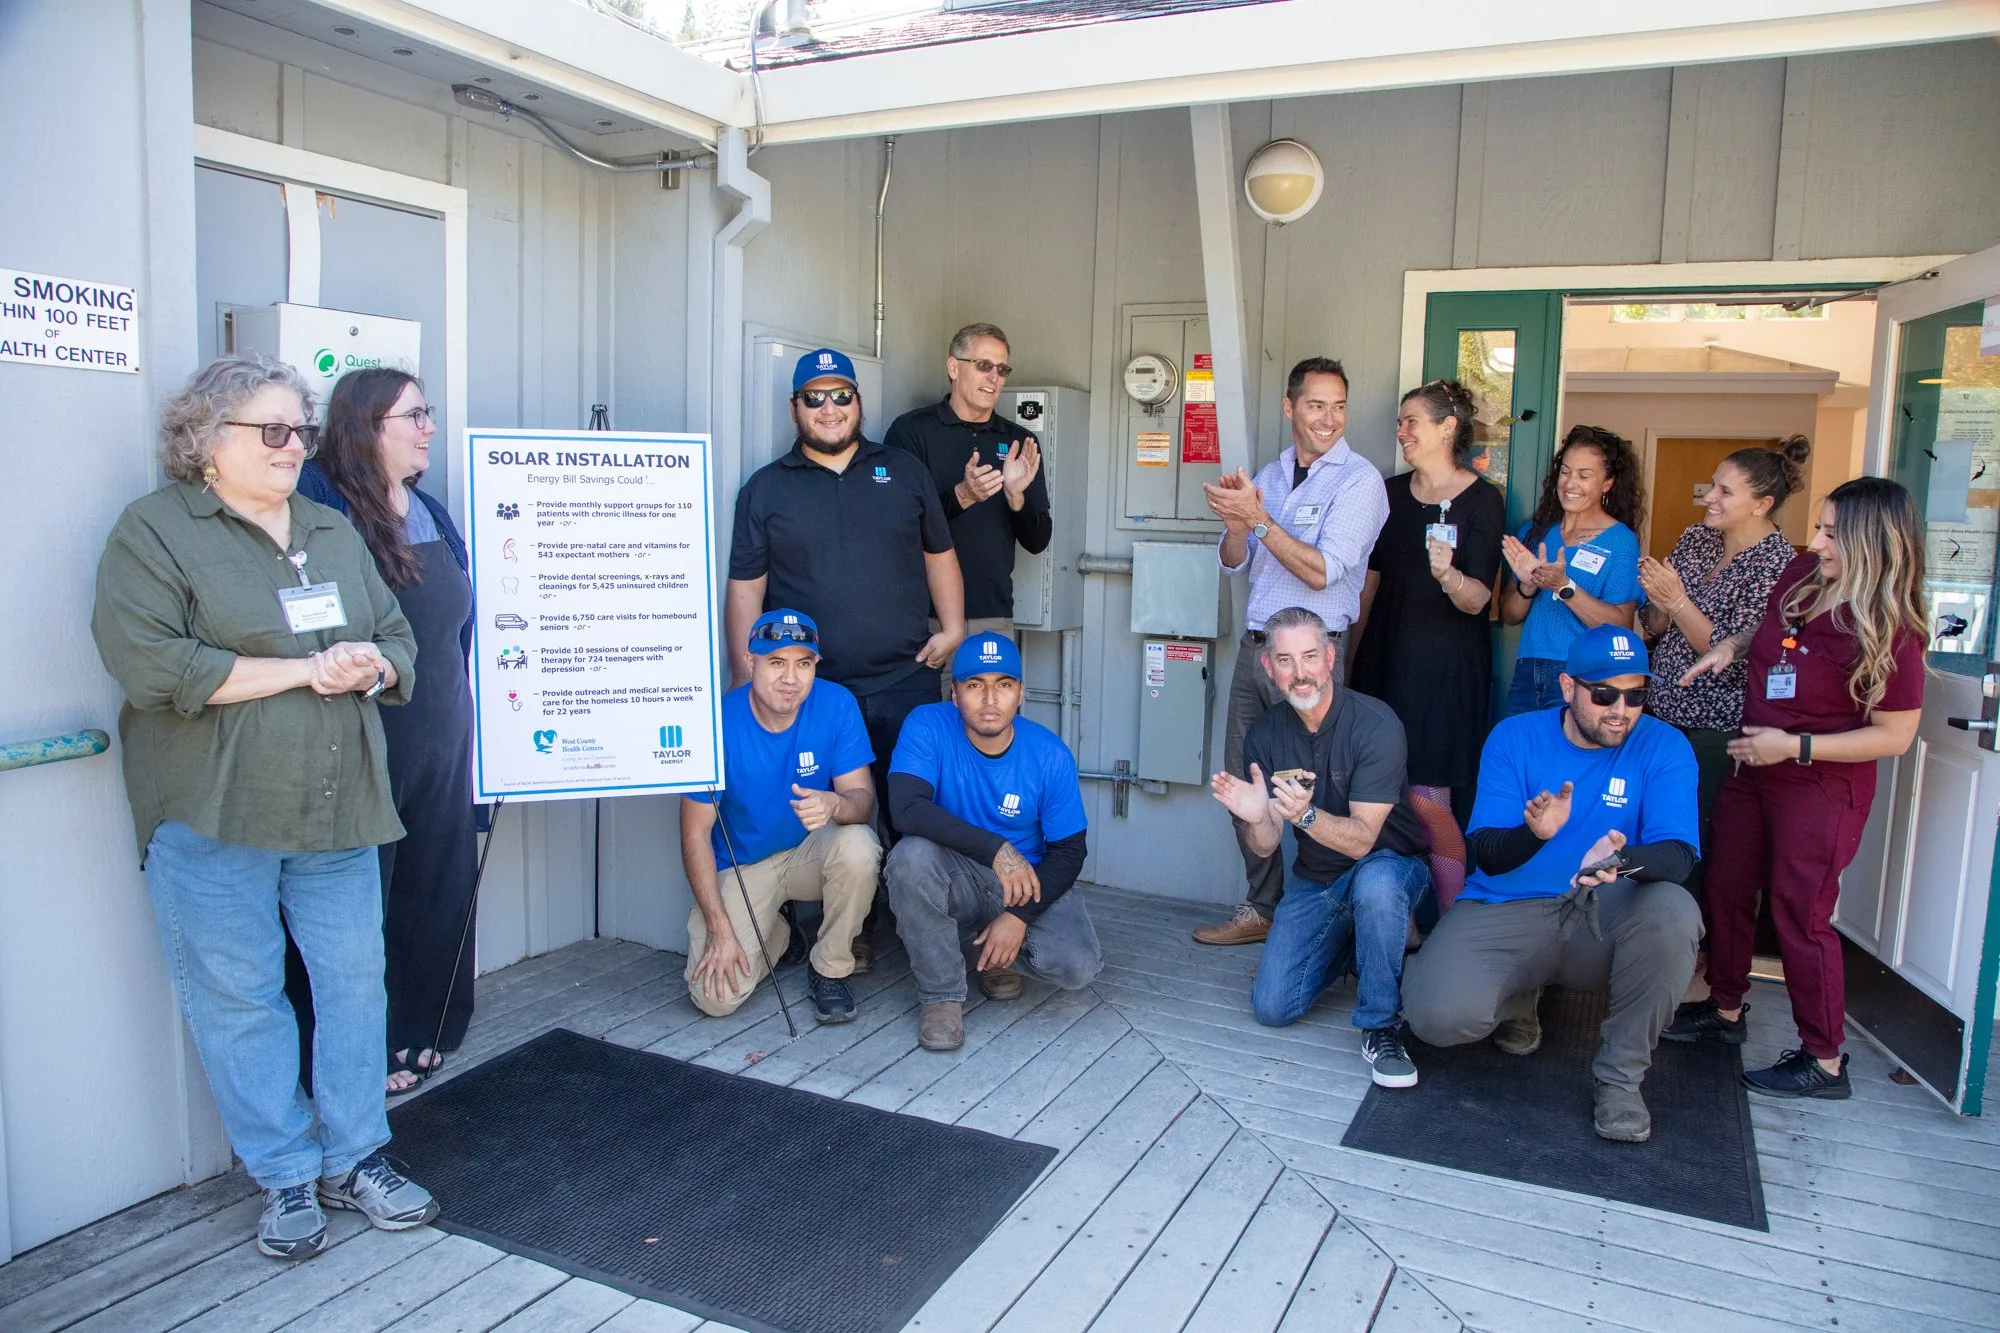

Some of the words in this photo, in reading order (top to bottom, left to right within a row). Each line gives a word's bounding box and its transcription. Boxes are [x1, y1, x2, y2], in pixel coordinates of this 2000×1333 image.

[14, 276, 133, 312] SMOKING
[0, 302, 35, 320] HIN
[45, 308, 78, 325] 100
[86, 313, 130, 331] FEET
[45, 329, 60, 338] OF
[56, 346, 127, 366] CENTER
[345, 354, 382, 368] Quest
[488, 451, 550, 465] SOLAR
[556, 452, 690, 468] INSTALLATION
[528, 474, 559, 484] Energy
[563, 475, 576, 483] Bill
[579, 475, 614, 485] Savings
[617, 476, 643, 484] Could
[569, 501, 601, 509] monthly
[537, 511, 569, 519] patients
[555, 552, 595, 560] expectant
[598, 574, 642, 582] screenings,
[538, 583, 576, 591] cleanings
[592, 582, 615, 590] 5,425
[572, 614, 595, 622] 6,750
[631, 645, 672, 653] counseling
[605, 655, 645, 663] teenagers
[541, 666, 584, 674] depression
[569, 708, 591, 716] years
[653, 750, 691, 758] TAYLOR
[796, 764, 820, 773] TAYLOR
[1602, 794, 1628, 804] TAYLOR
